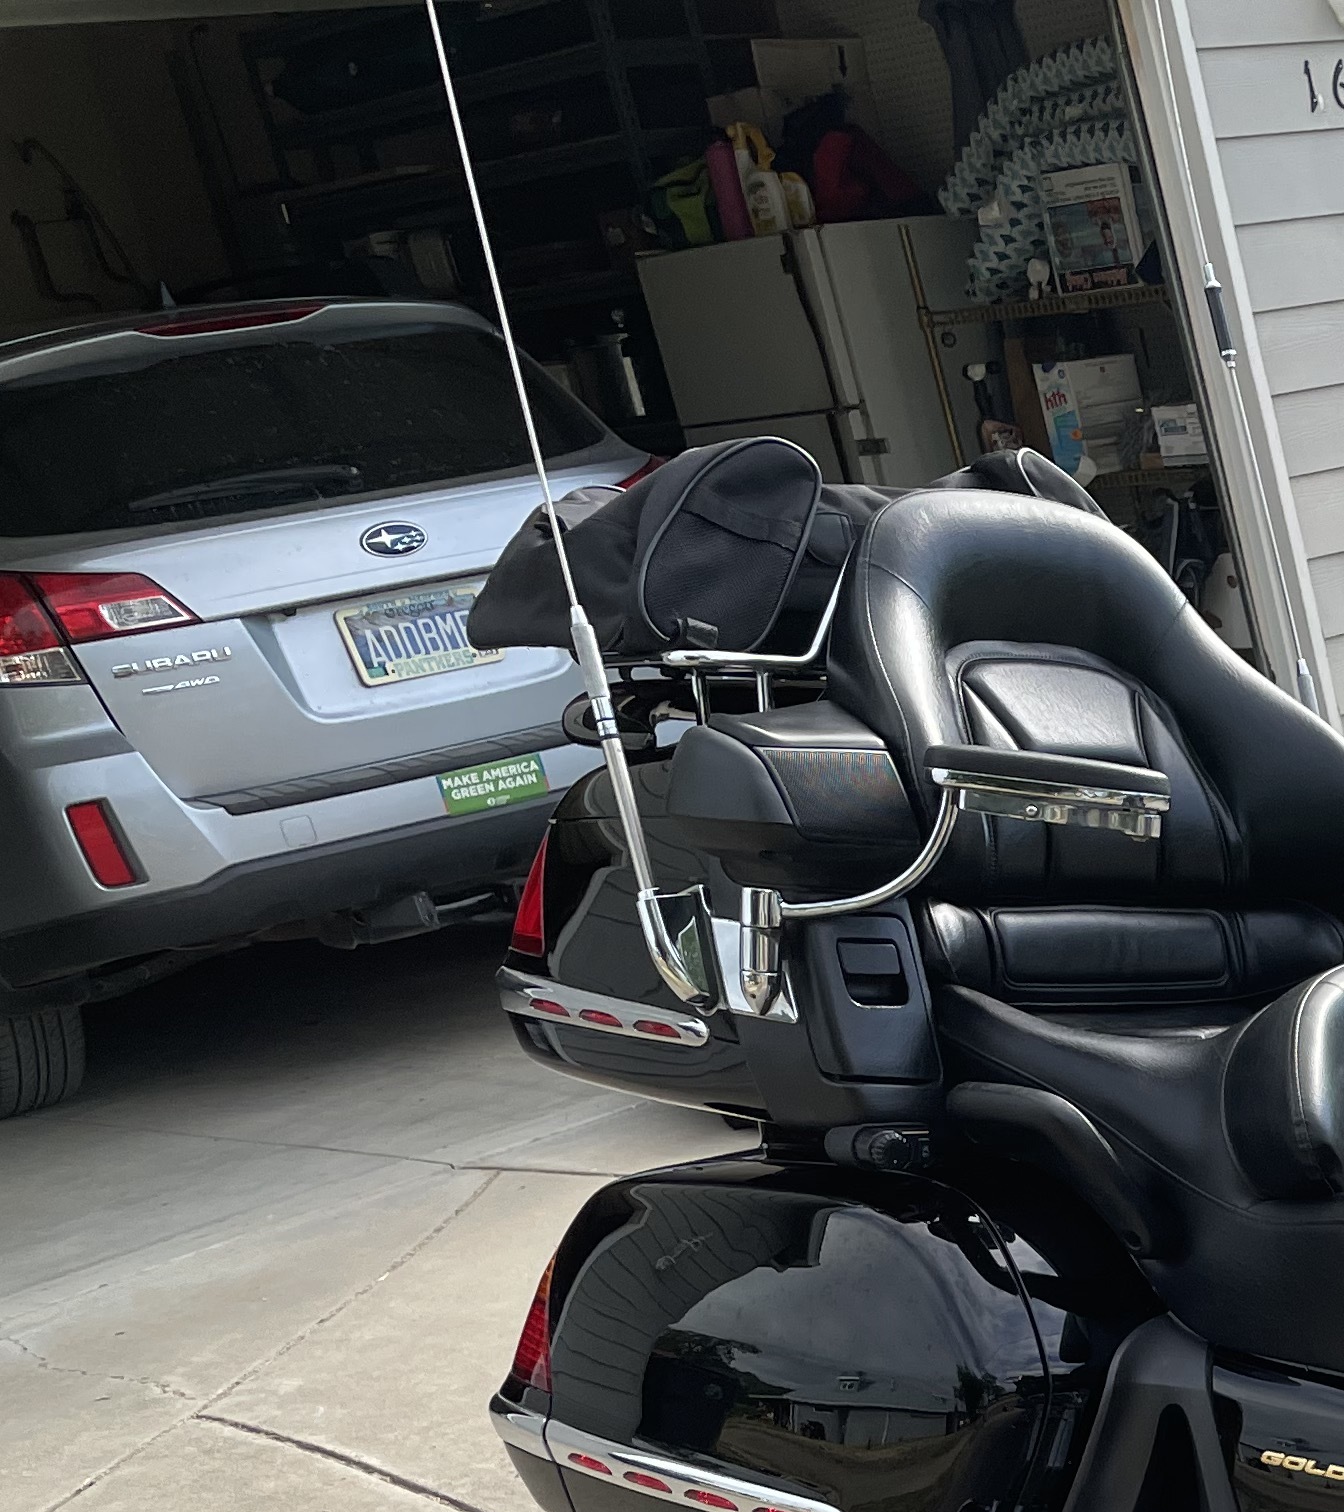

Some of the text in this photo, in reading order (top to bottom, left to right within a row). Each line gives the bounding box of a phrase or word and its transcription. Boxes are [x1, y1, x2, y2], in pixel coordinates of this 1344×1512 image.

[111, 645, 232, 679] SUBARU
[393, 651, 475, 677] PANTHERS
[175, 675, 221, 690] AWD
[441, 760, 540, 790] MAKE AMERICA
[451, 782, 496, 801] GREEN
[498, 773, 538, 791] AGAIN
